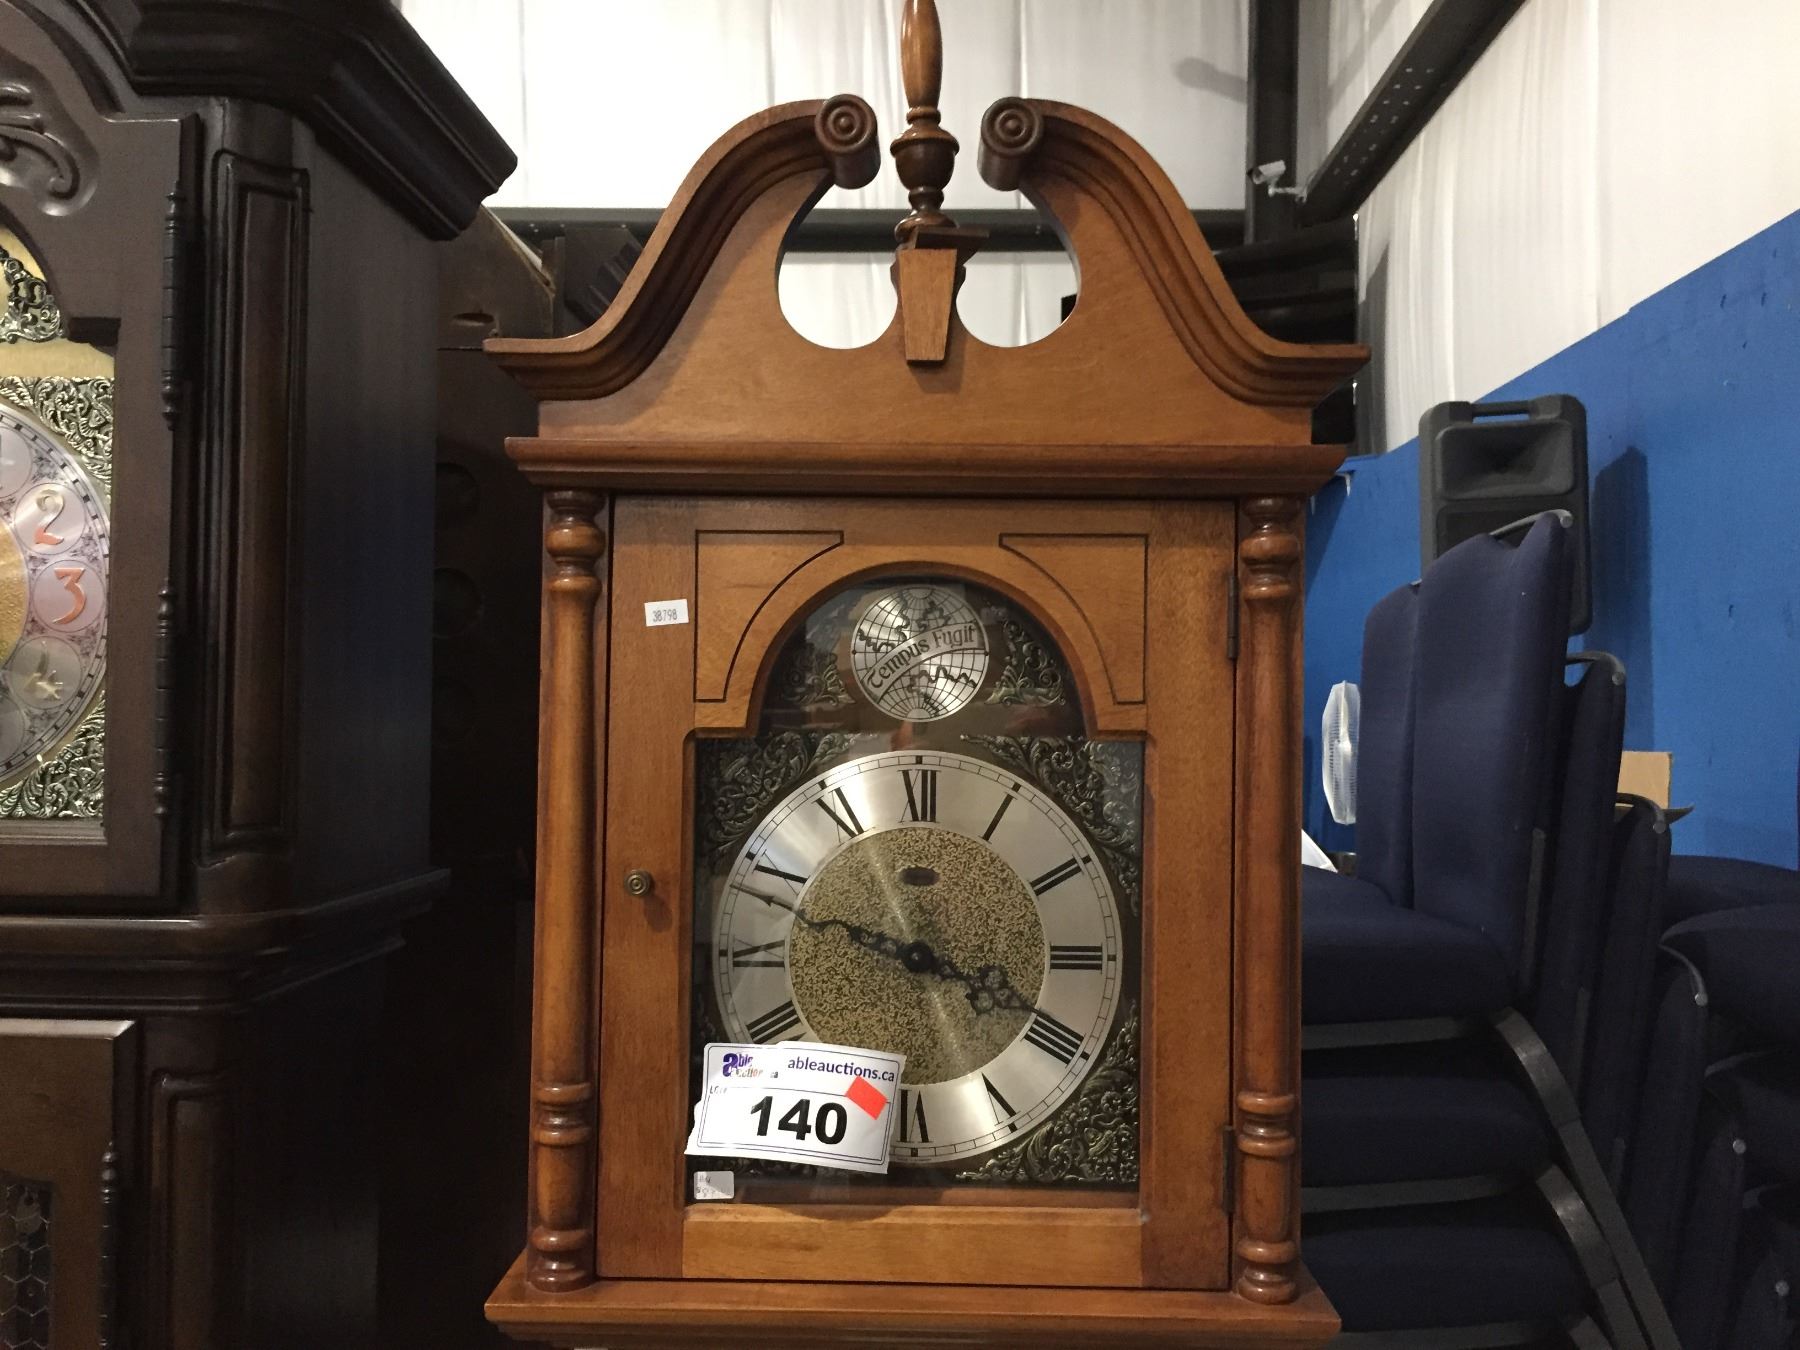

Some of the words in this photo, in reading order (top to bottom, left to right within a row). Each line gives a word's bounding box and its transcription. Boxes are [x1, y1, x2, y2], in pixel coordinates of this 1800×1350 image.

[54, 567, 85, 625] 3
[866, 639, 930, 689] Tempus
[932, 625, 977, 649] Fugit
[812, 785, 875, 848] XI
[898, 769, 941, 824] XII
[979, 791, 1017, 845] I
[752, 849, 811, 896] X
[1028, 854, 1083, 901] II
[732, 935, 787, 973] IX
[1049, 942, 1103, 975] III
[787, 1057, 895, 1082] ableauctions.ca
[750, 1096, 848, 1145] 140
[981, 1072, 1021, 1126] V
